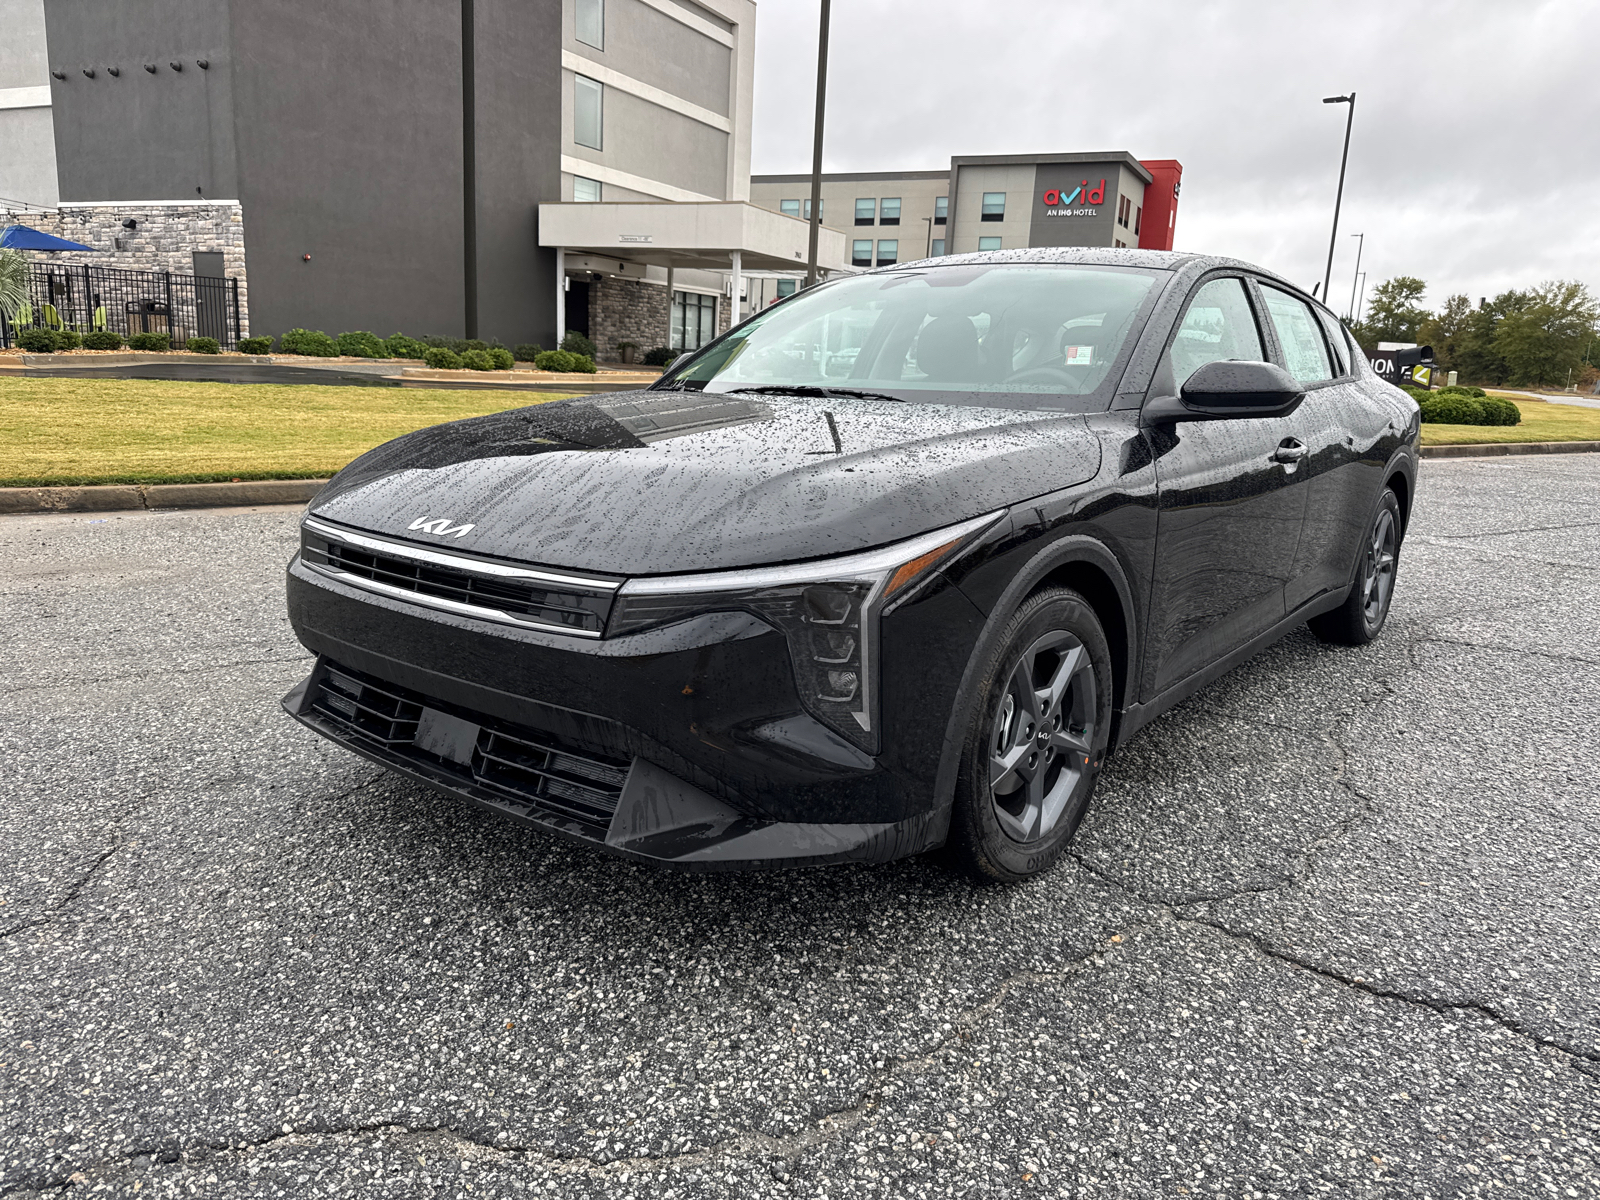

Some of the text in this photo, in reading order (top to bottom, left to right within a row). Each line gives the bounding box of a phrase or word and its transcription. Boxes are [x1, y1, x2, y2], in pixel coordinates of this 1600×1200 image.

[1043, 179, 1106, 206] avid
[1047, 208, 1097, 217] AN IHG HOTEL
[407, 515, 476, 539] KIA
